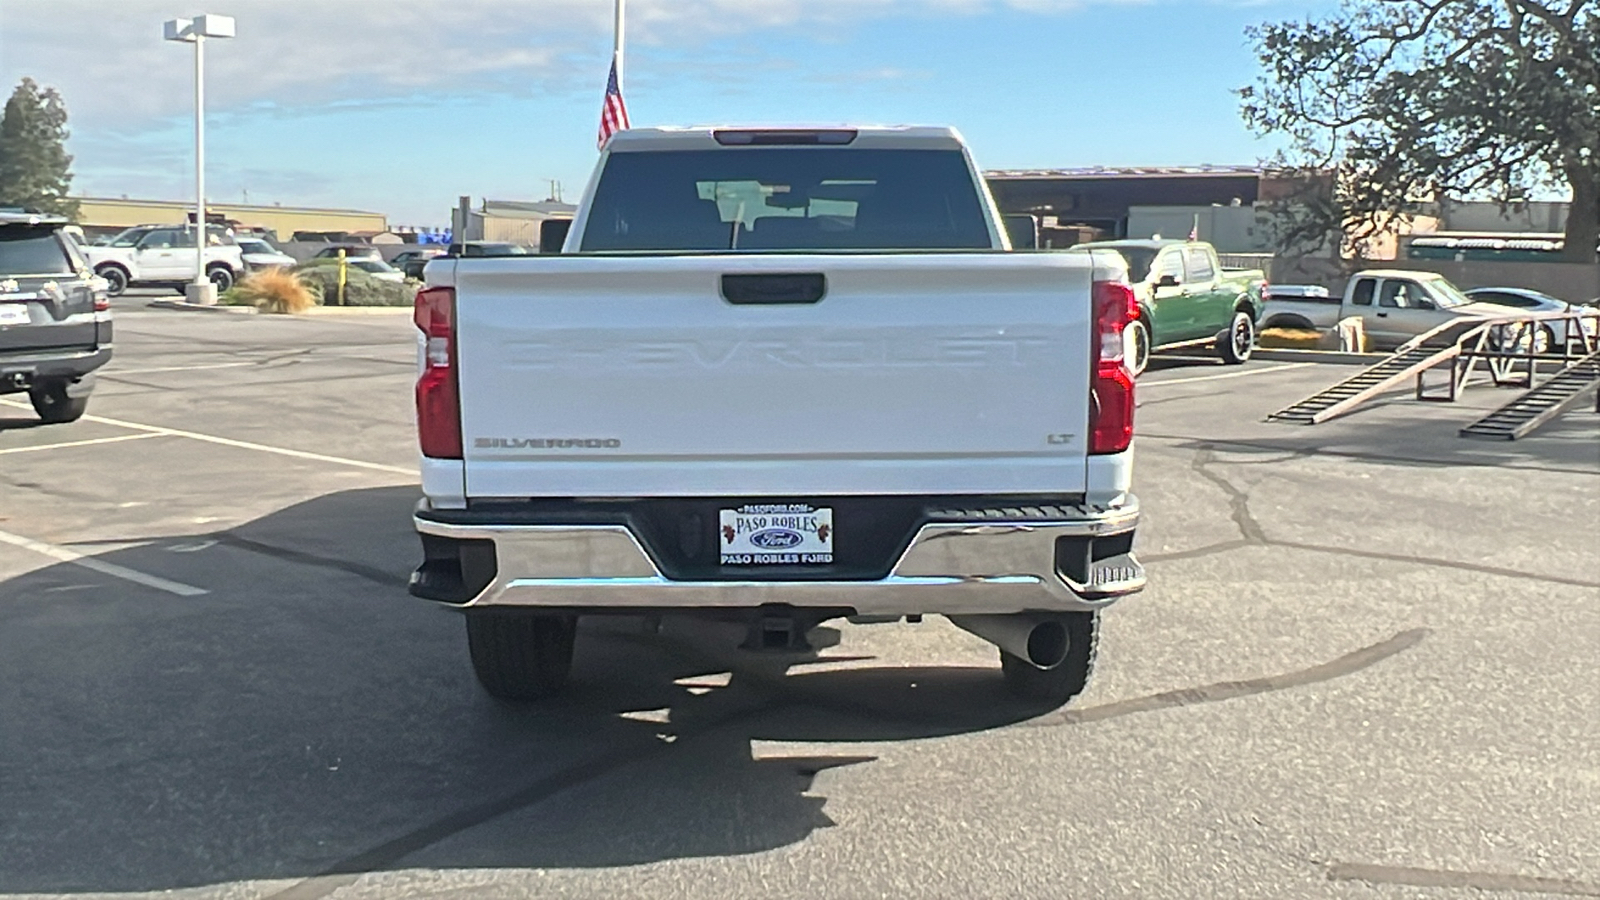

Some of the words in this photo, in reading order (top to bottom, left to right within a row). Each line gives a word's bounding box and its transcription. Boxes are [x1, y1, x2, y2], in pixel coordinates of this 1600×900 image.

[475, 438, 621, 448] SILVERADO
[1048, 434, 1075, 444] LT
[736, 517, 767, 534] PASO
[771, 516, 818, 533] ROBLES
[760, 532, 793, 546] Ford
[721, 554, 752, 563] PASO
[754, 554, 798, 563] ROBLES
[802, 554, 833, 563] FORD
